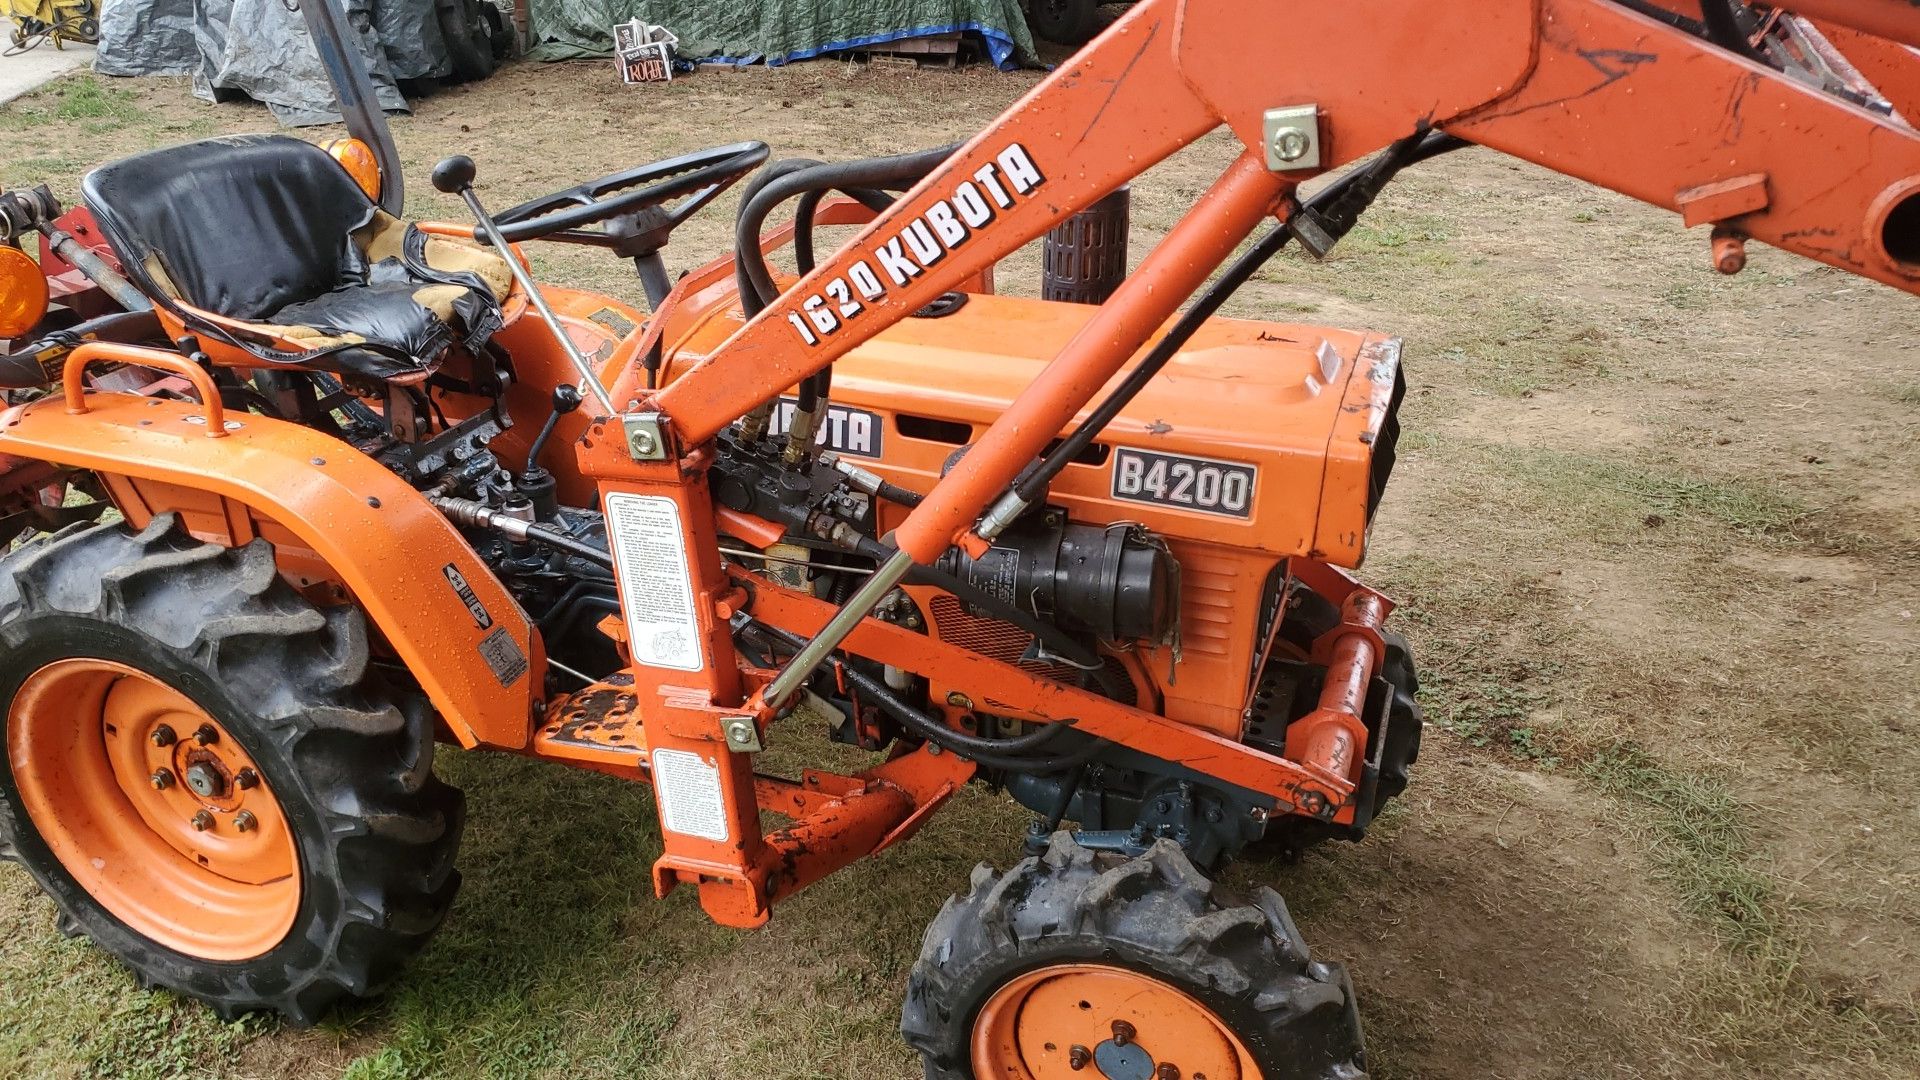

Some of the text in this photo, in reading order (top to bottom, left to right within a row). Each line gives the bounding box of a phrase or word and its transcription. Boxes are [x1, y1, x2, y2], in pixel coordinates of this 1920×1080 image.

[629, 60, 666, 81] ROGUE
[787, 143, 1047, 345] 1620 KUBOTA
[1117, 454, 1249, 511] B4200
